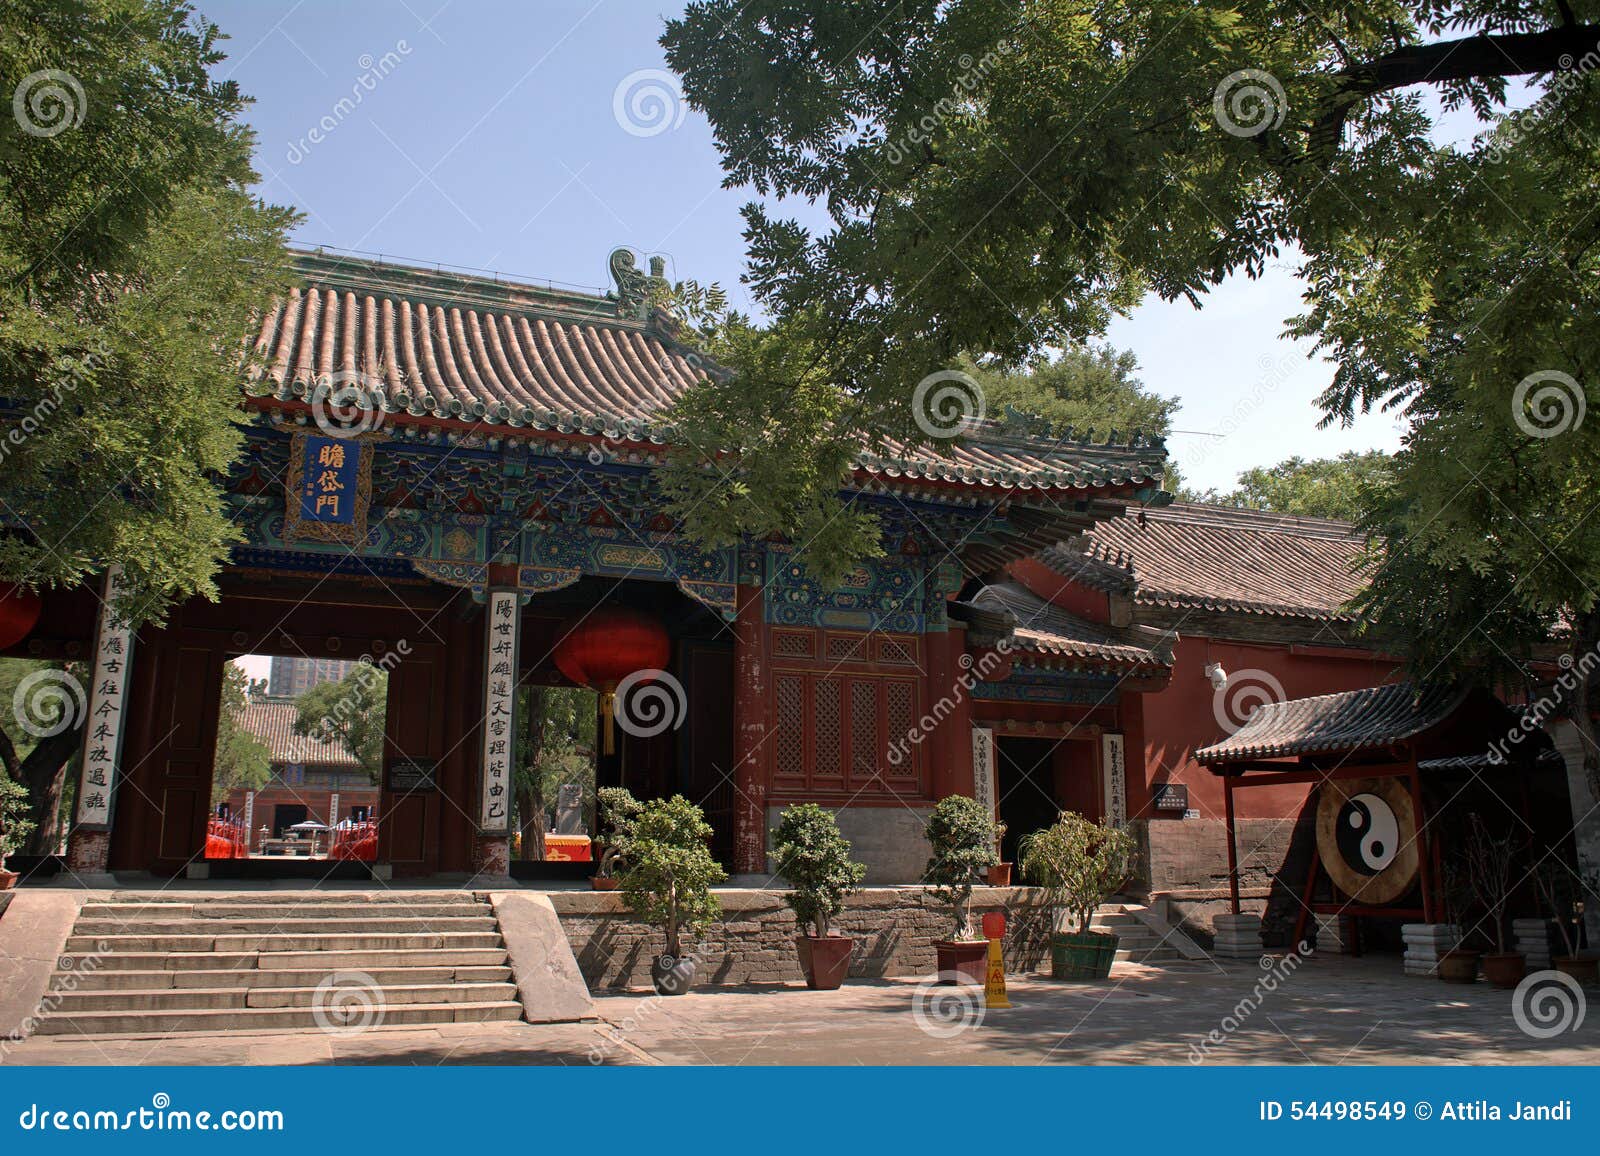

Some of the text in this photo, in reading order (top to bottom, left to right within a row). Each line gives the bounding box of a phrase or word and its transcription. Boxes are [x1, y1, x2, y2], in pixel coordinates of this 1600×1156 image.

[315, 443, 346, 517] 瞻岱門
[83, 573, 130, 811] 報應古往今來放過誰
